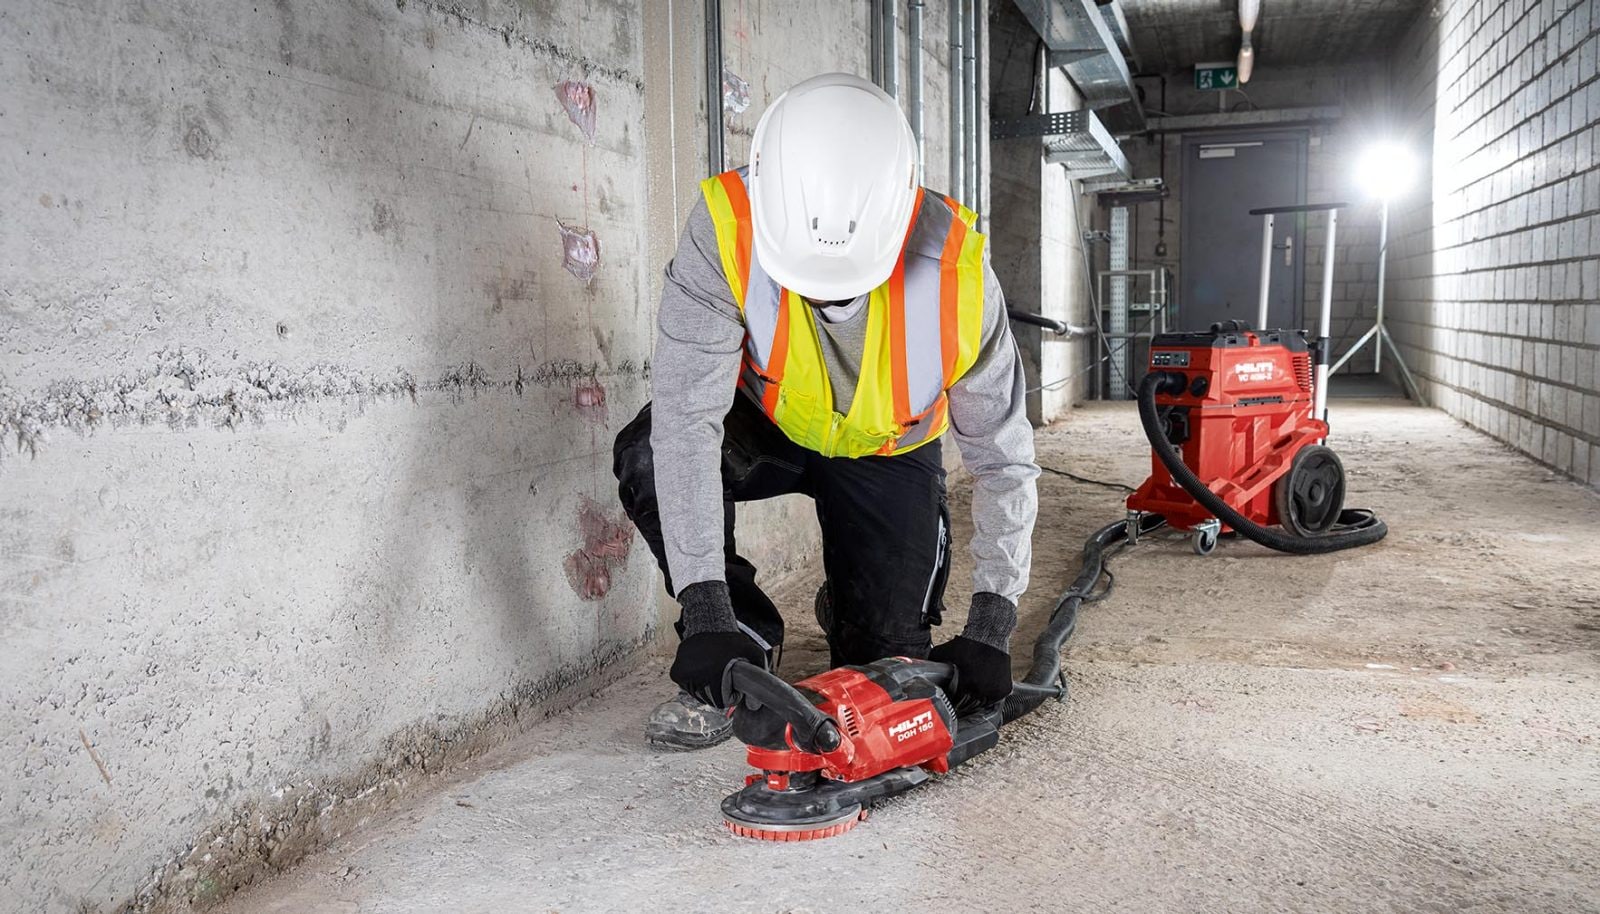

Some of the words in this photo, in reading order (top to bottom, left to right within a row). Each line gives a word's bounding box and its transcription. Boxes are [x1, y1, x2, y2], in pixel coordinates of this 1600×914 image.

[1235, 362, 1273, 374] HILTI
[1238, 374, 1249, 382] VC
[889, 711, 932, 737] HILTI
[898, 728, 917, 742] DGH
[919, 721, 934, 733] 150
